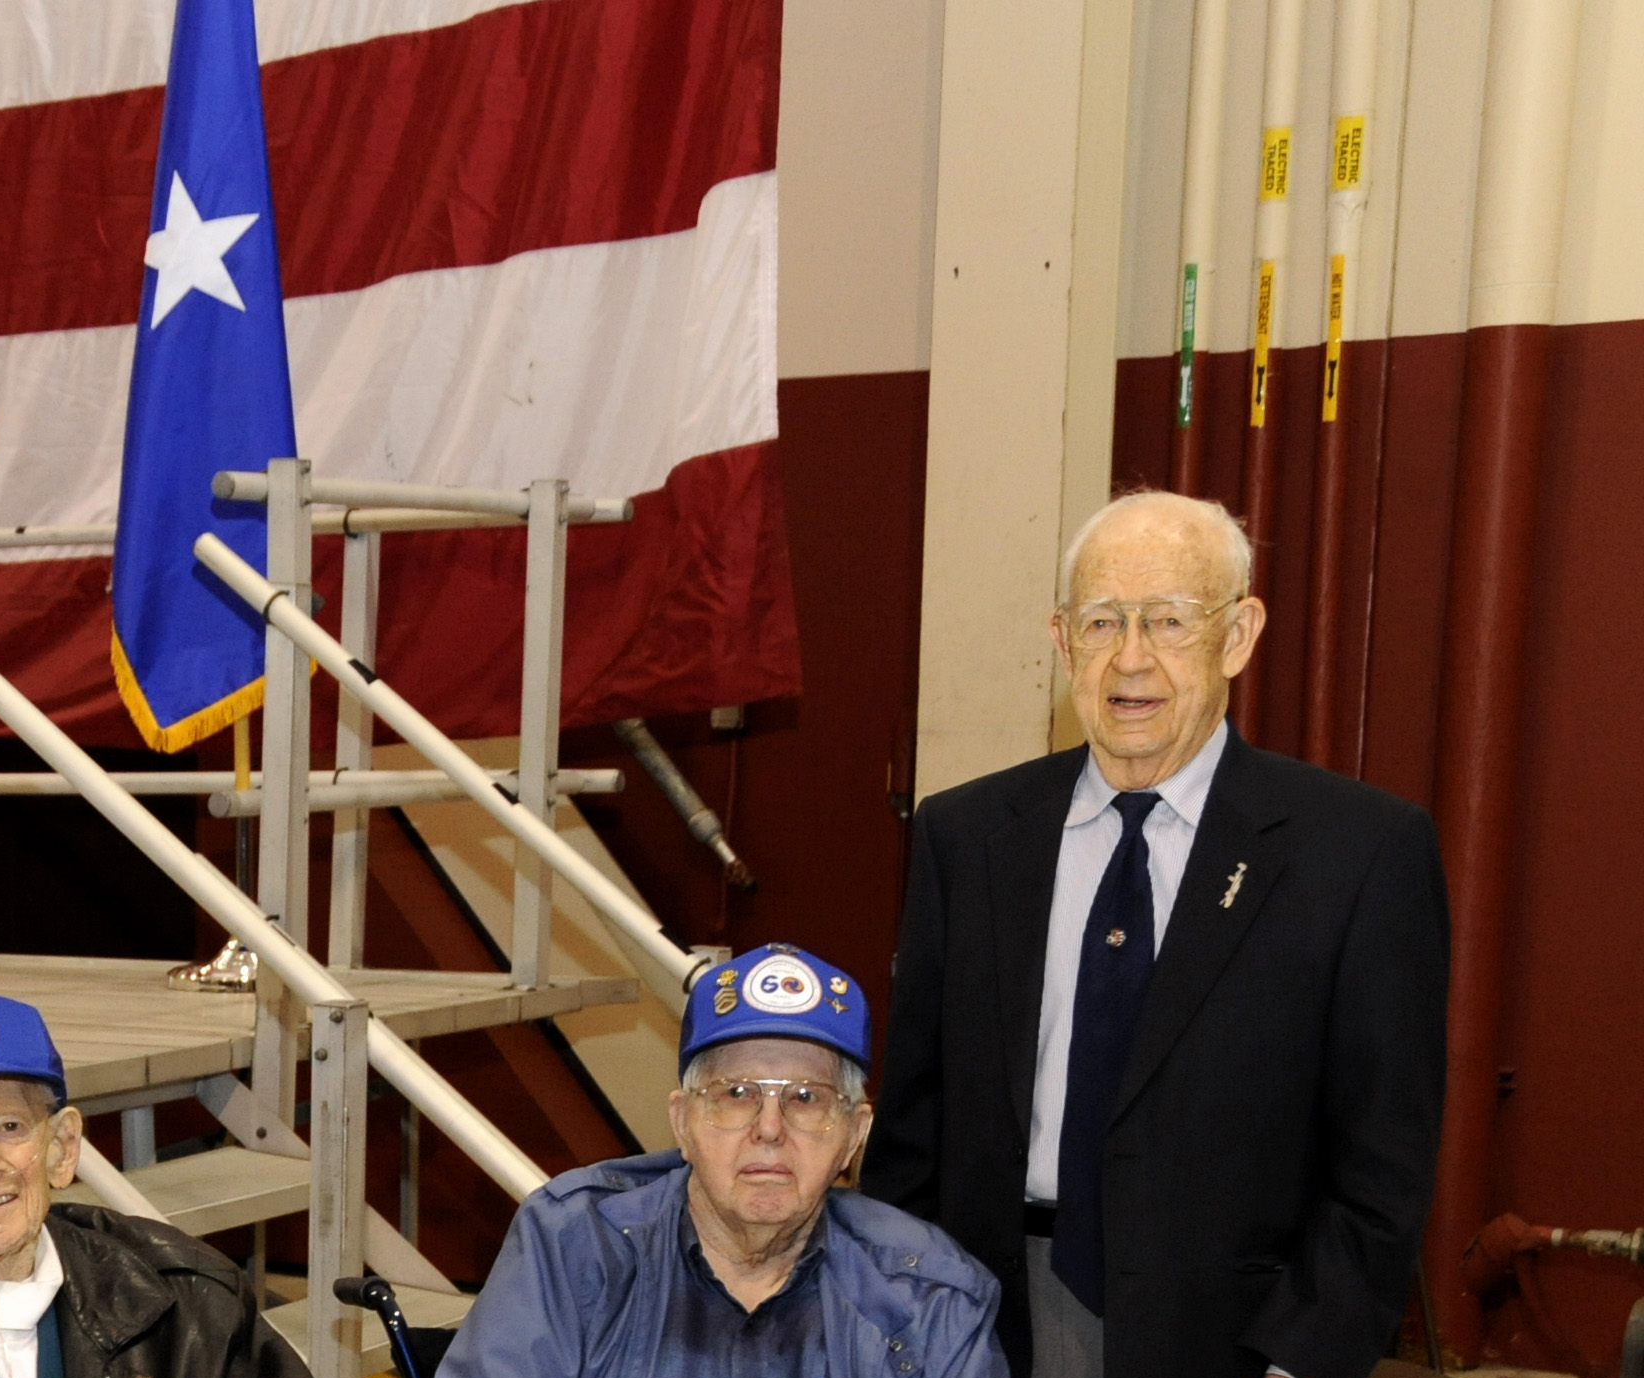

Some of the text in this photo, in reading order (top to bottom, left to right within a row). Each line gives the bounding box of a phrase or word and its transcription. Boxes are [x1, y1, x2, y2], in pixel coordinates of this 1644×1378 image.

[1265, 144, 1277, 191] TRACED
[1276, 139, 1289, 195] ELECTRIC
[1337, 133, 1349, 181] TRACED
[1349, 127, 1362, 184] ELECTRIC
[1258, 275, 1272, 335] DETERGENT
[1330, 292, 1341, 321] WATER
